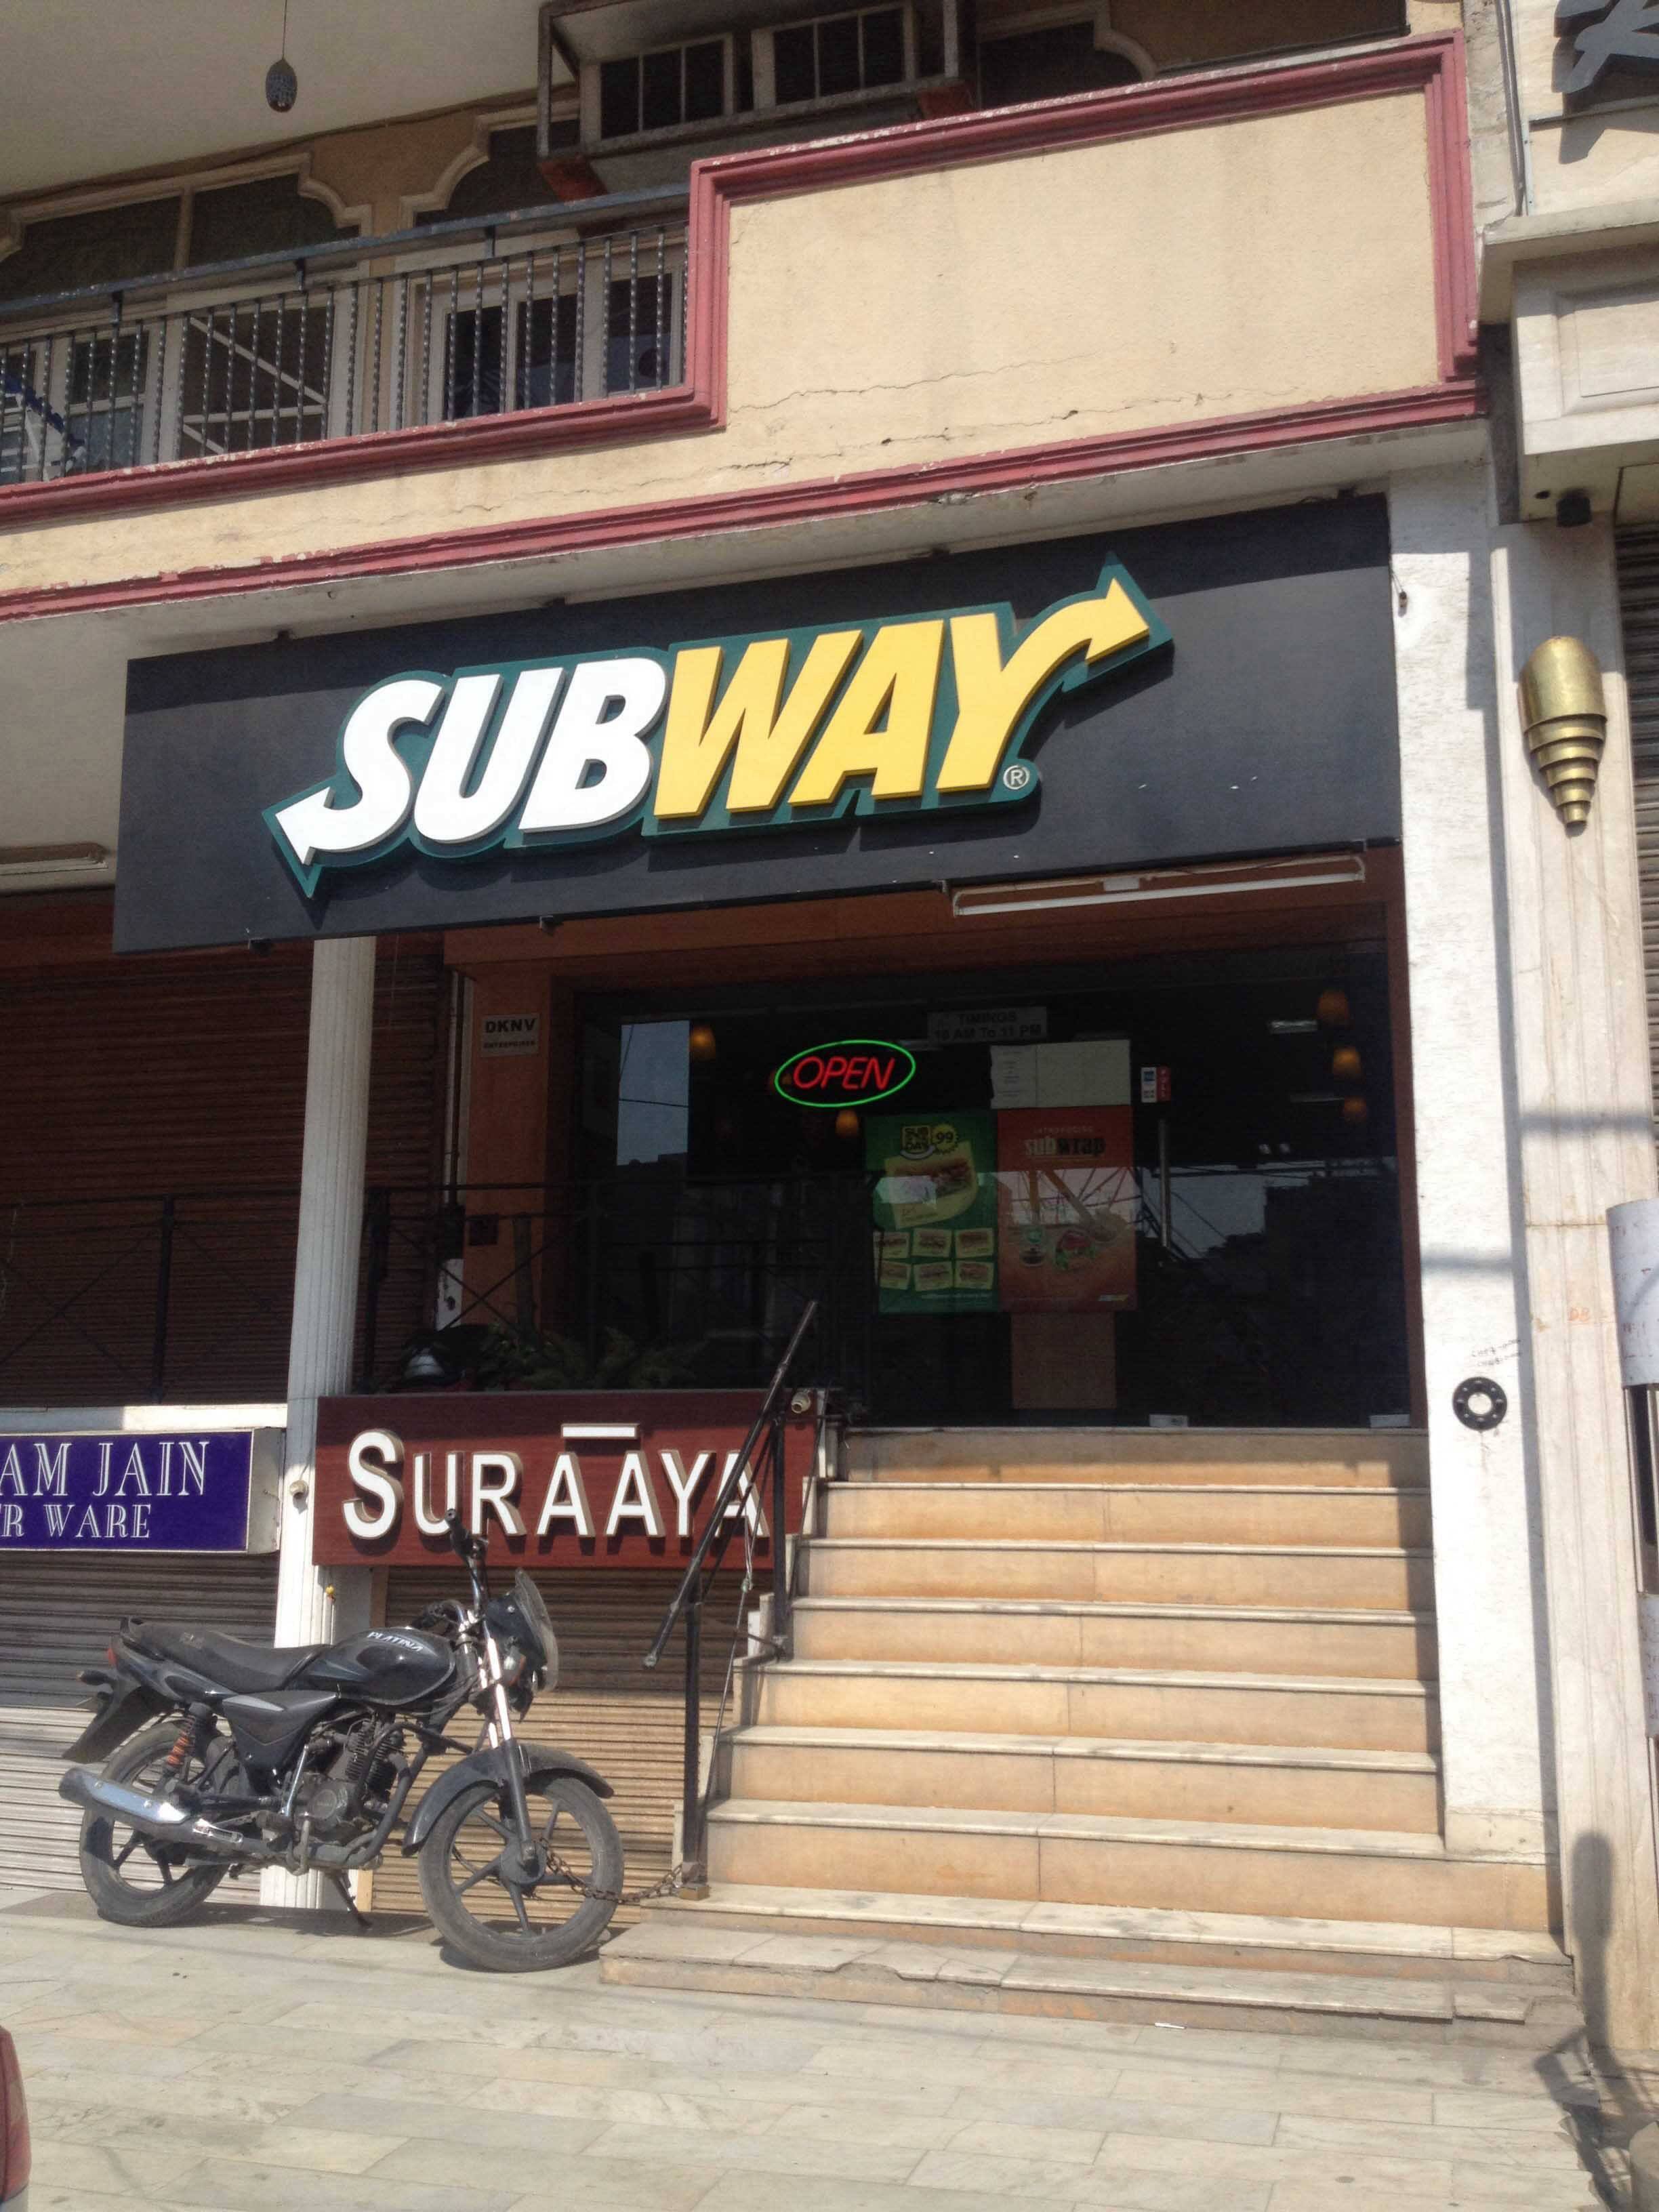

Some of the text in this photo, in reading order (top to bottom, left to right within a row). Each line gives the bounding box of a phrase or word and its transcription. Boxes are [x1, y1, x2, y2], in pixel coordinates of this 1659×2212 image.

[274, 577, 1150, 866] SUBWAY
[793, 1055, 895, 1090] OPEN
[92, 1441, 211, 1496] JAIN
[43, 1503, 152, 1538] WARE
[367, 1631, 424, 1652] PLATINA
